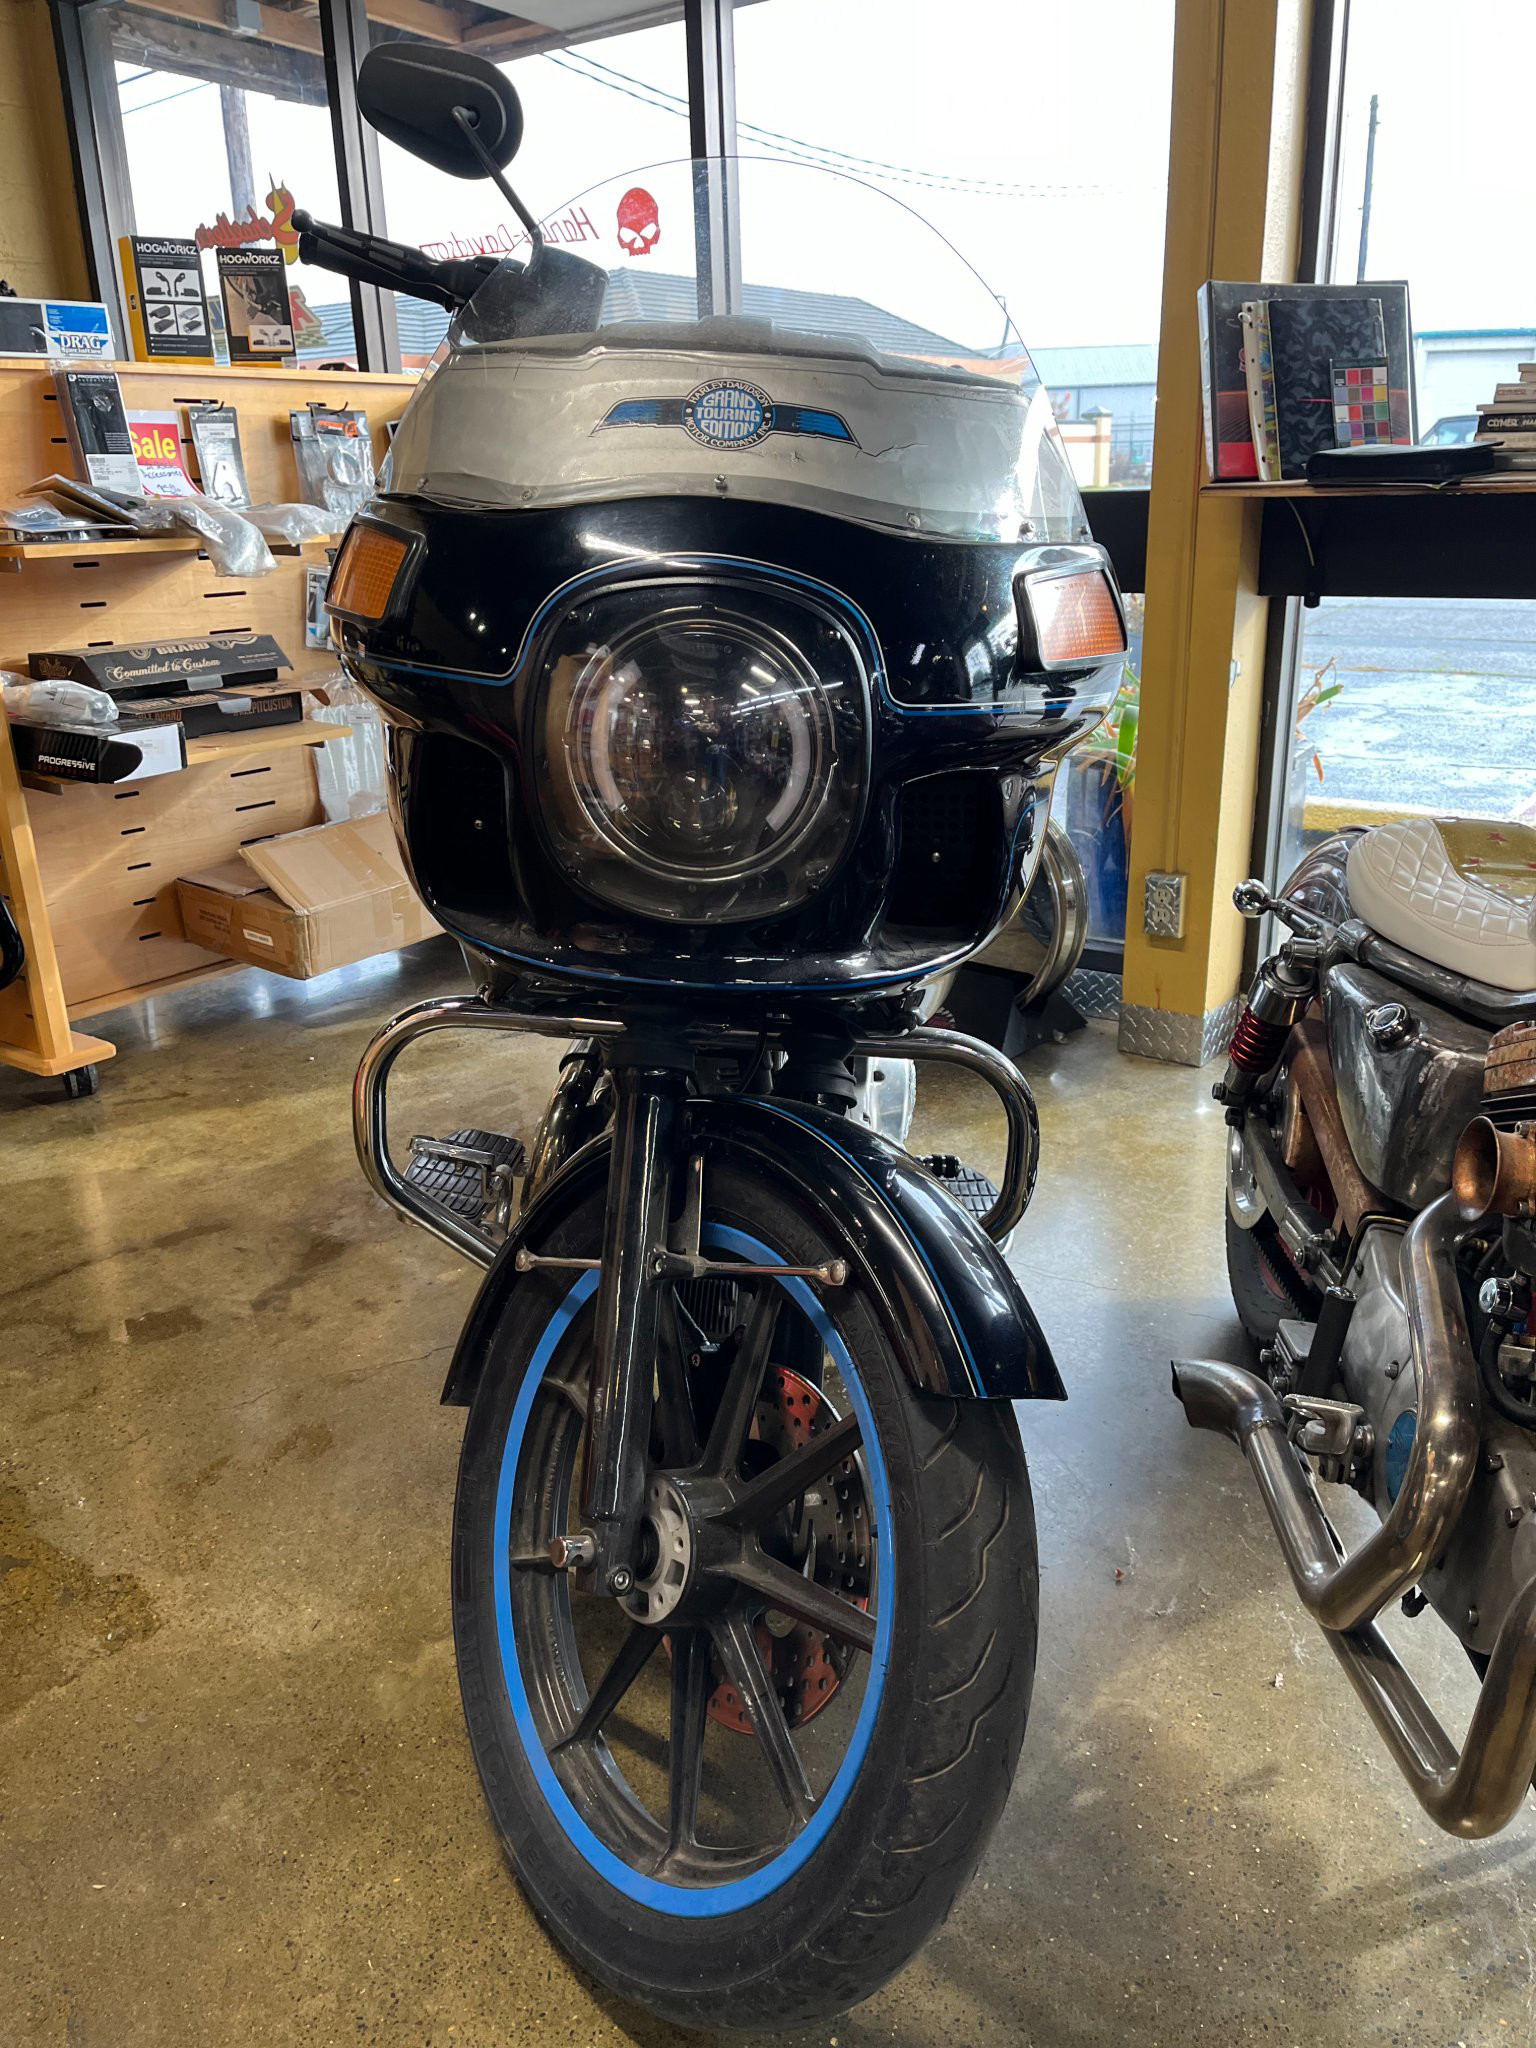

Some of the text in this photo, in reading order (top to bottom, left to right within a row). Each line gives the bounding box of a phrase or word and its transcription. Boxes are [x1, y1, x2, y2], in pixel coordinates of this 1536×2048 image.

[136, 241, 198, 255] HOGWORKZ
[219, 252, 281, 265] HOGWORKZ
[60, 335, 101, 349] DRAG
[689, 381, 771, 408] HARLEY-DAVIDSON
[702, 390, 756, 409] GRAND
[696, 407, 761, 422] TOURING
[685, 416, 710, 443] MOTOR
[710, 433, 758, 448] COMPANY
[700, 420, 755, 439] EDITION
[130, 430, 177, 459] Sale
[104, 660, 170, 682] Committed
[171, 661, 181, 672] to
[180, 657, 221, 674] Custom
[38, 755, 96, 771] PROGRESSIVE
